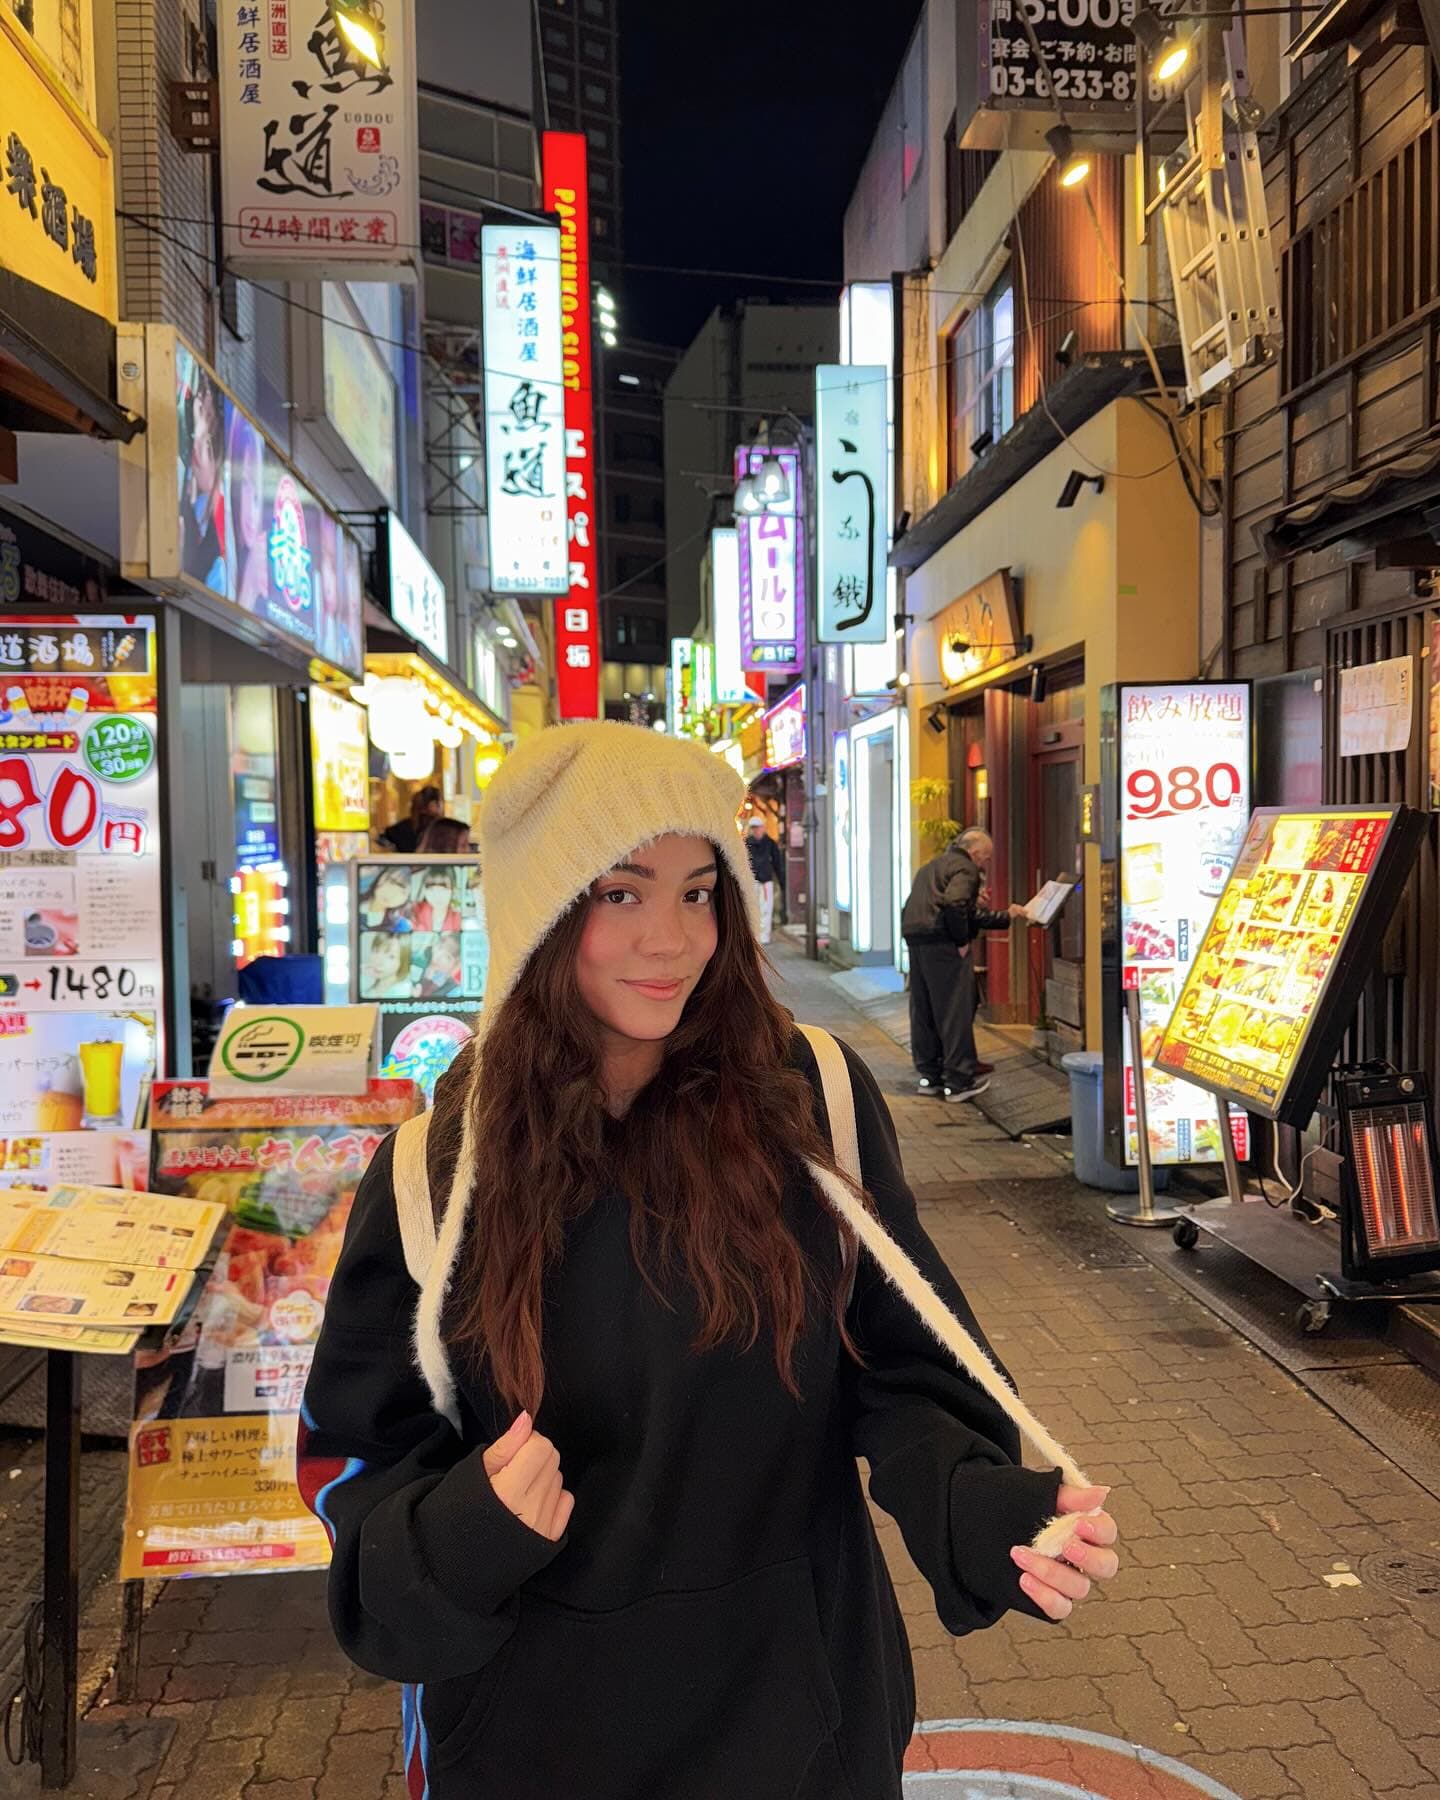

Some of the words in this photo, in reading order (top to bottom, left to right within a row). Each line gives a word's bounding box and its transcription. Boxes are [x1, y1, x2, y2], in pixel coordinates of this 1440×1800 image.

[236, 0, 262, 104] 鮮居酒屋
[271, 0, 288, 55] 洲直送
[0, 131, 97, 284] 衆酒場
[248, 214, 390, 246] 24時間営業
[553, 187, 579, 312] PACHINKO
[515, 240, 539, 363] 海鮮居酒屋
[562, 331, 581, 392] SLOT
[565, 429, 591, 668] エスパス日拓
[1126, 692, 1243, 724] 飲み放題
